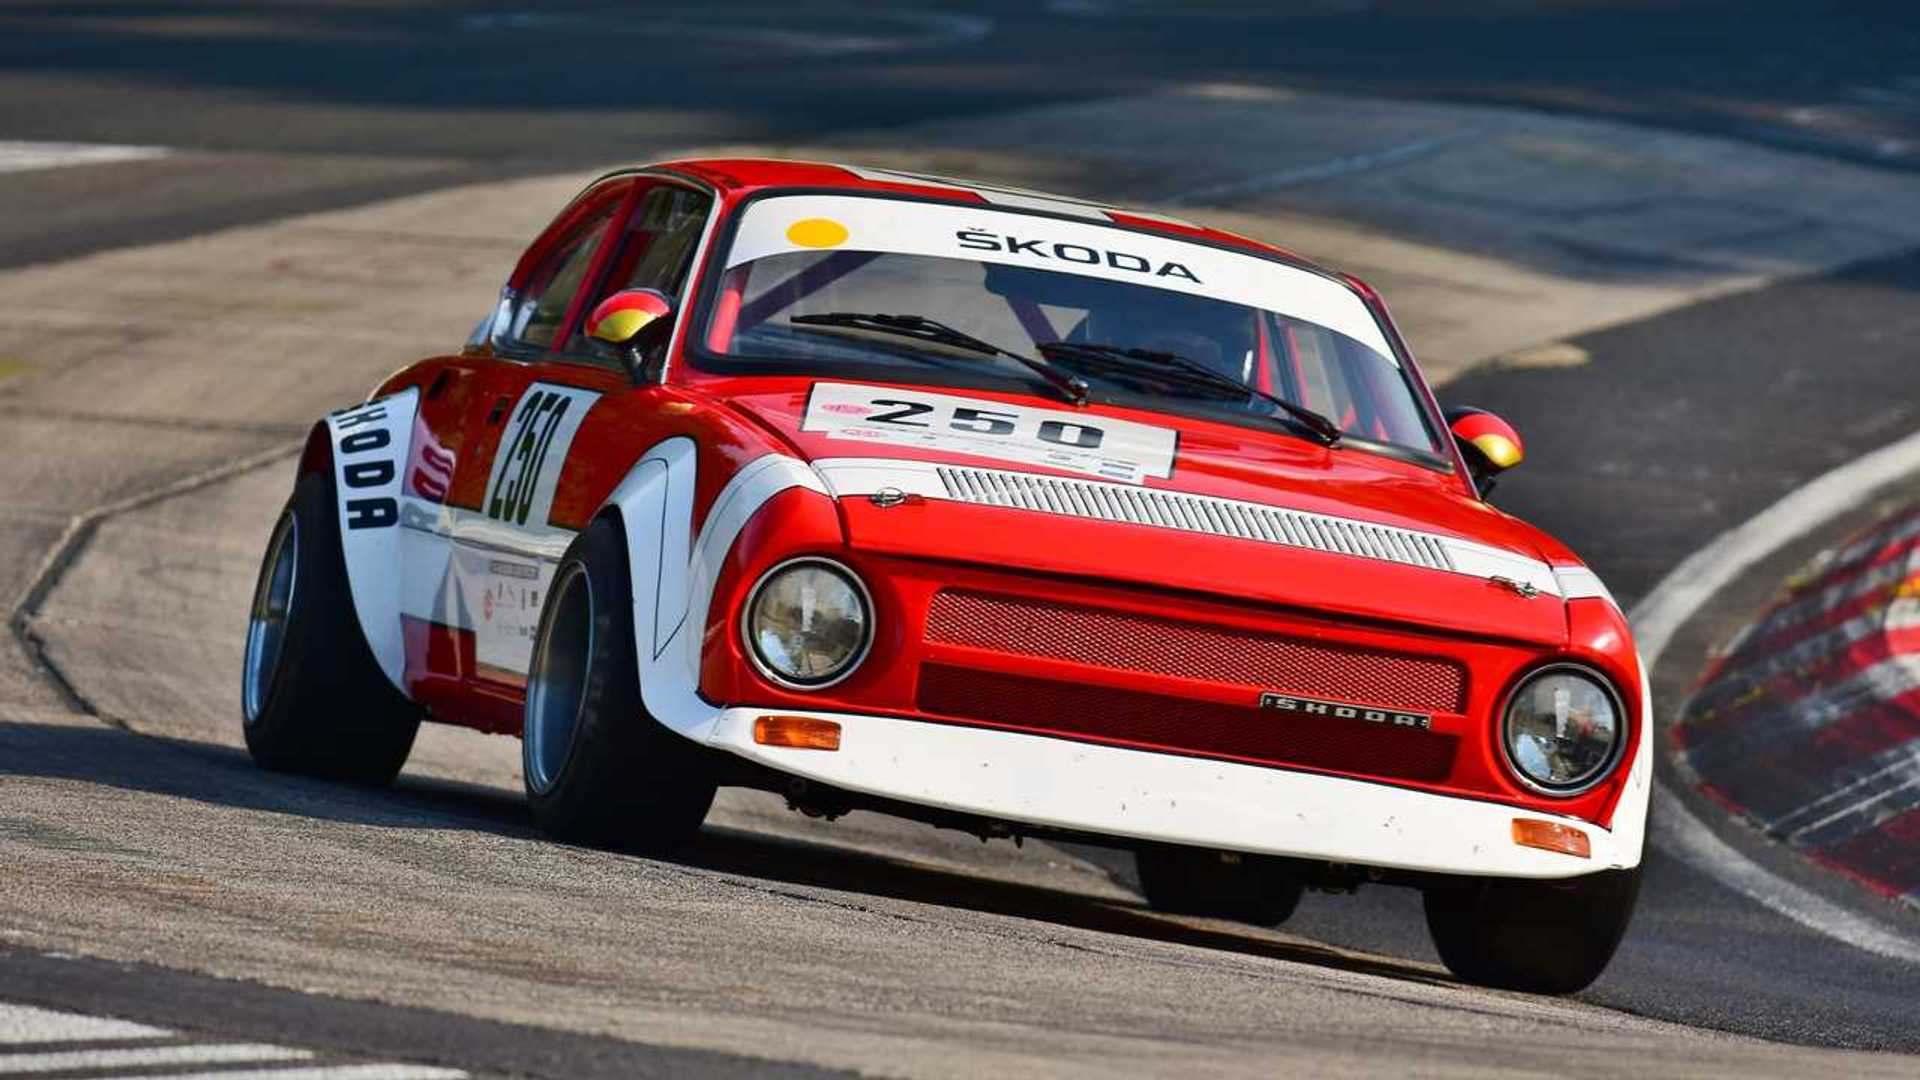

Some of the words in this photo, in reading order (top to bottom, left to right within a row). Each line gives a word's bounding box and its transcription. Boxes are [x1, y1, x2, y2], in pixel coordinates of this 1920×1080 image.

[957, 227, 1204, 284] ŠKODA
[866, 399, 1104, 448] 250
[489, 390, 572, 526] 250
